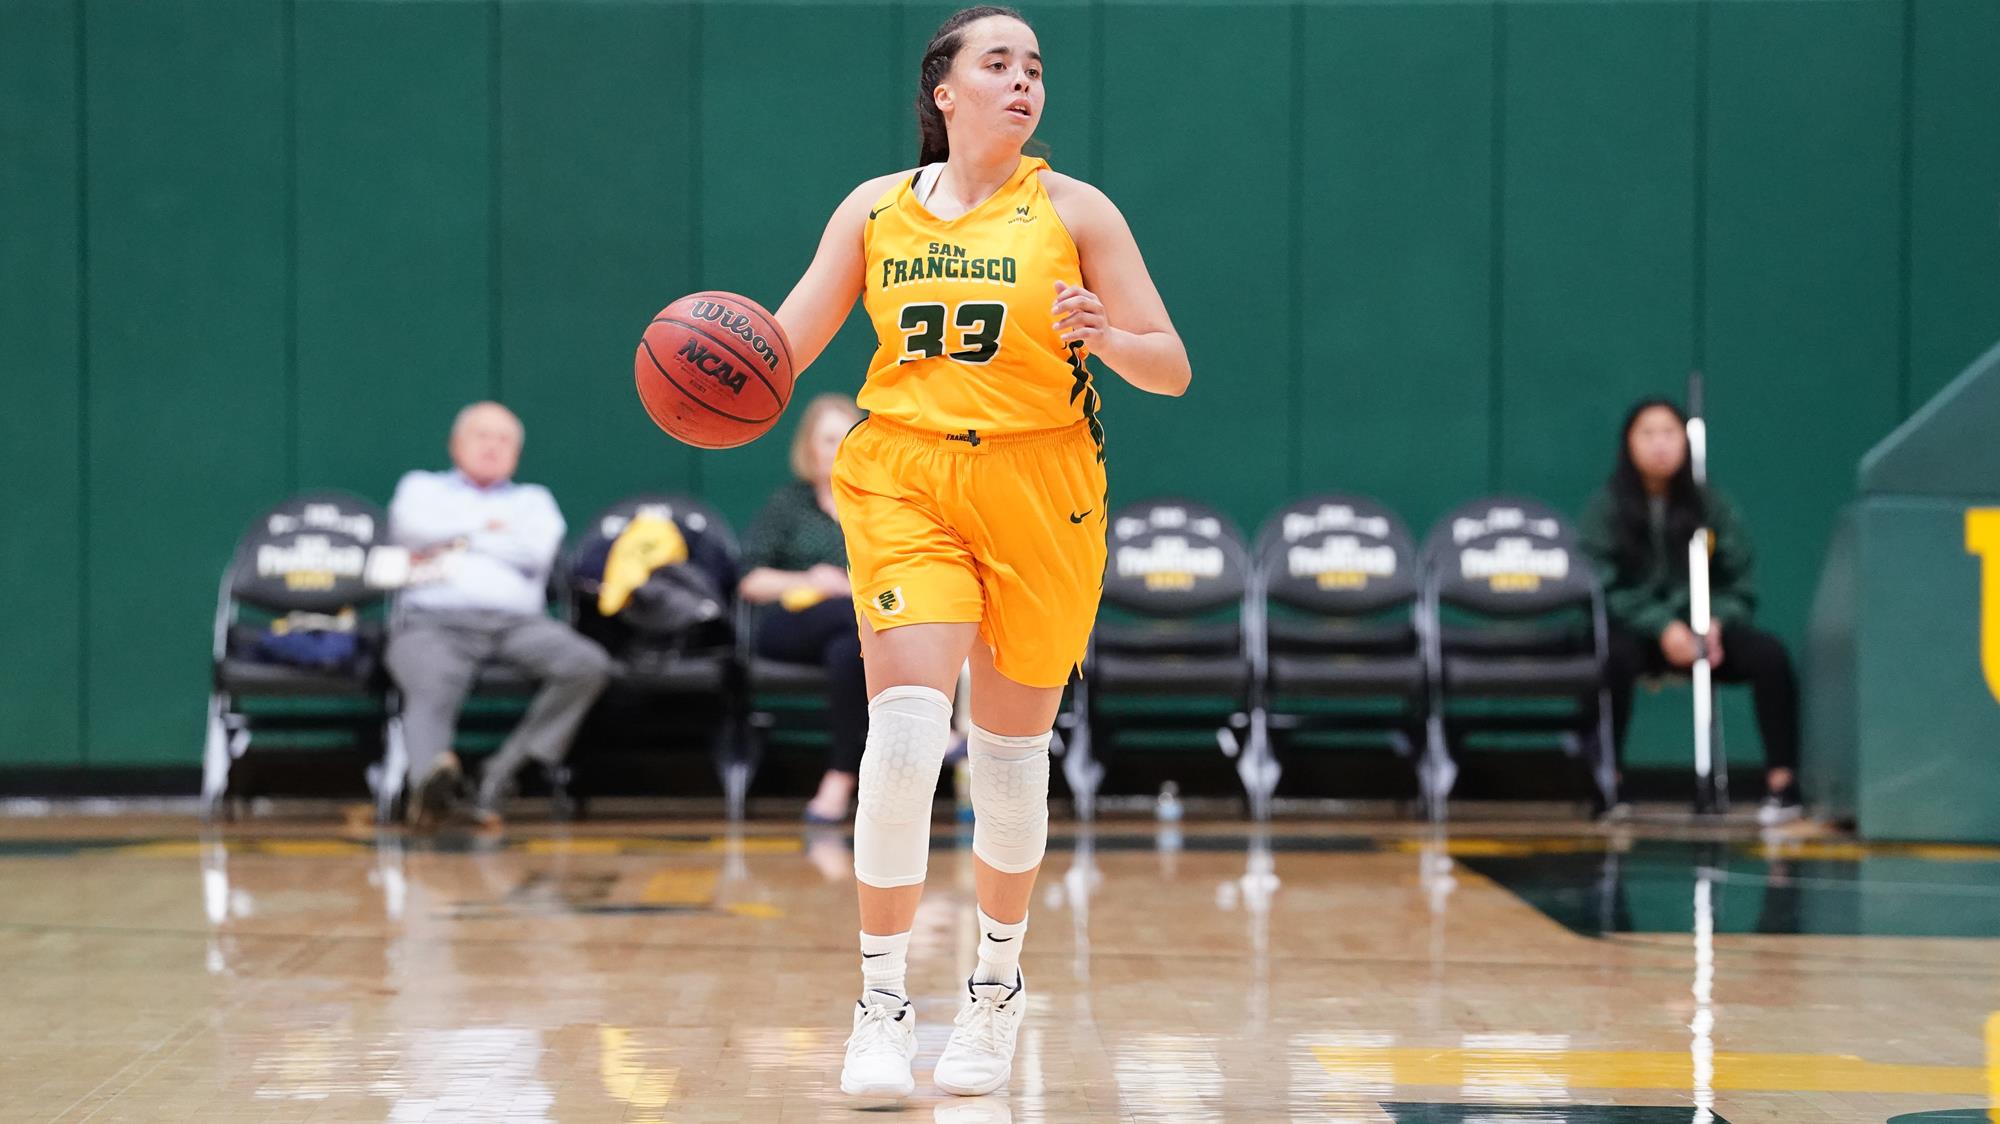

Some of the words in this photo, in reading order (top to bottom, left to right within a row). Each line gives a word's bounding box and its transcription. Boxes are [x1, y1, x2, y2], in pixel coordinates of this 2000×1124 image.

[928, 242, 966, 258] SAN
[882, 256, 1016, 290] FRANCISCO
[691, 301, 779, 372] Wilson
[898, 300, 1008, 366] 33
[678, 339, 748, 395] NCAA
[945, 433, 981, 445] FRANCIO
